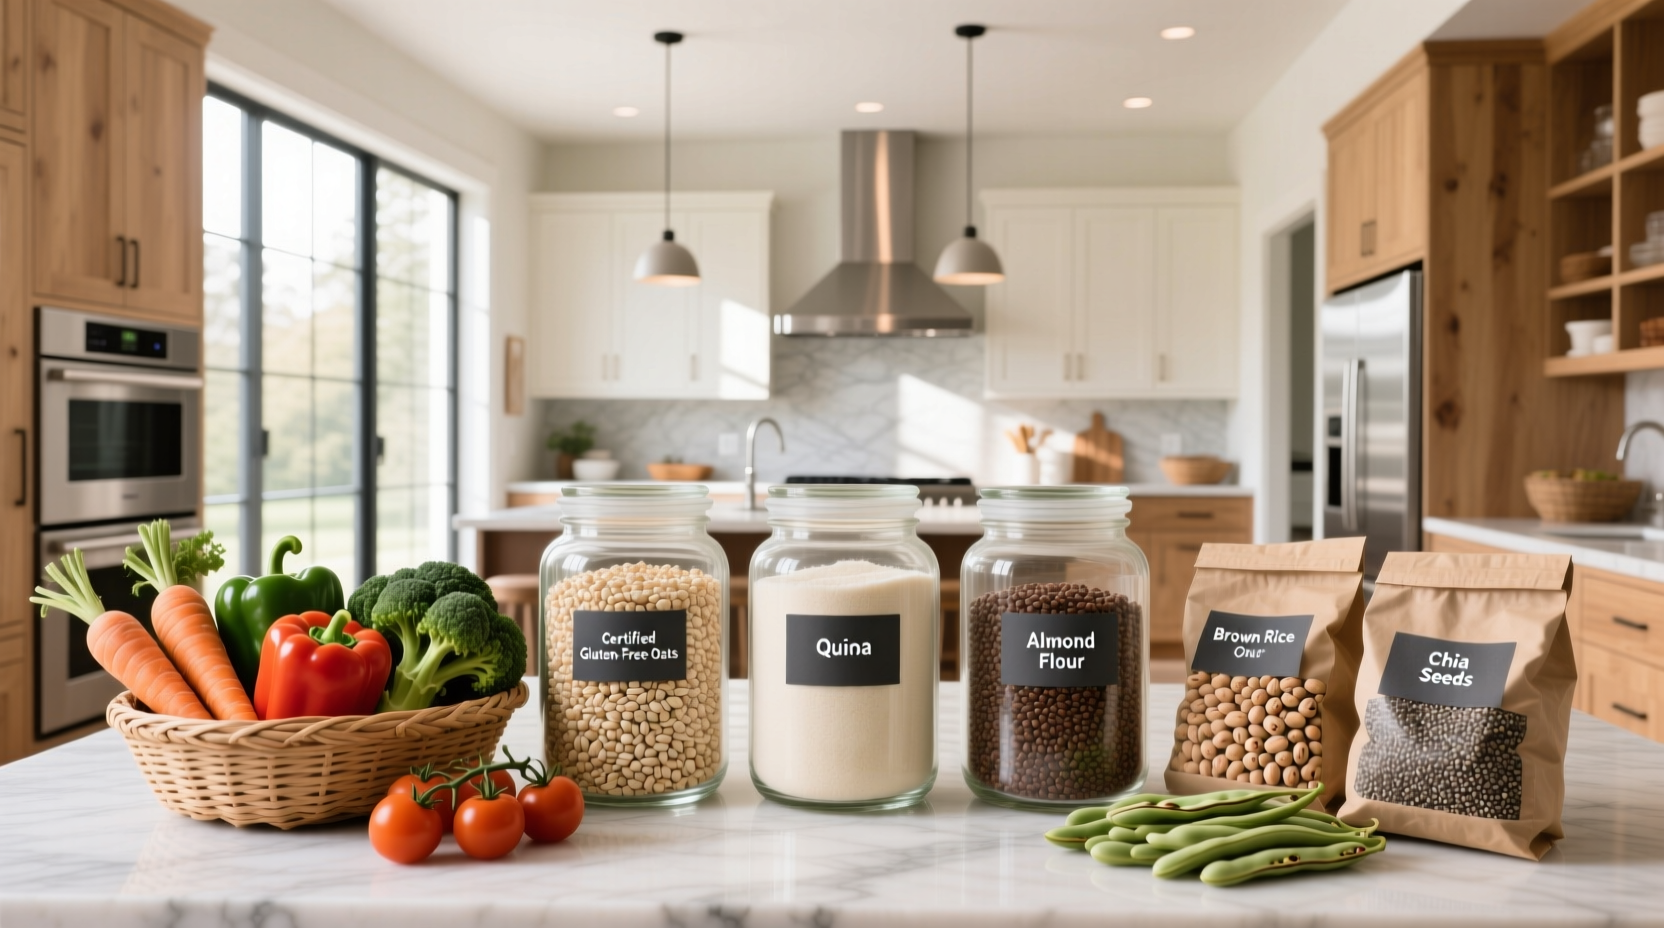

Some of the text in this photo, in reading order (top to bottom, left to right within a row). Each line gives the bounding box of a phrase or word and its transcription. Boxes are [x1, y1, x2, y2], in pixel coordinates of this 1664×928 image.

[601, 630, 656, 645] Certified
[1025, 630, 1095, 650] Almond
[1212, 626, 1261, 644] Brown
[815, 637, 872, 659] Quina
[1039, 652, 1085, 670] Flour
[1428, 650, 1470, 670] Chia
[1418, 666, 1475, 688] Seeds
